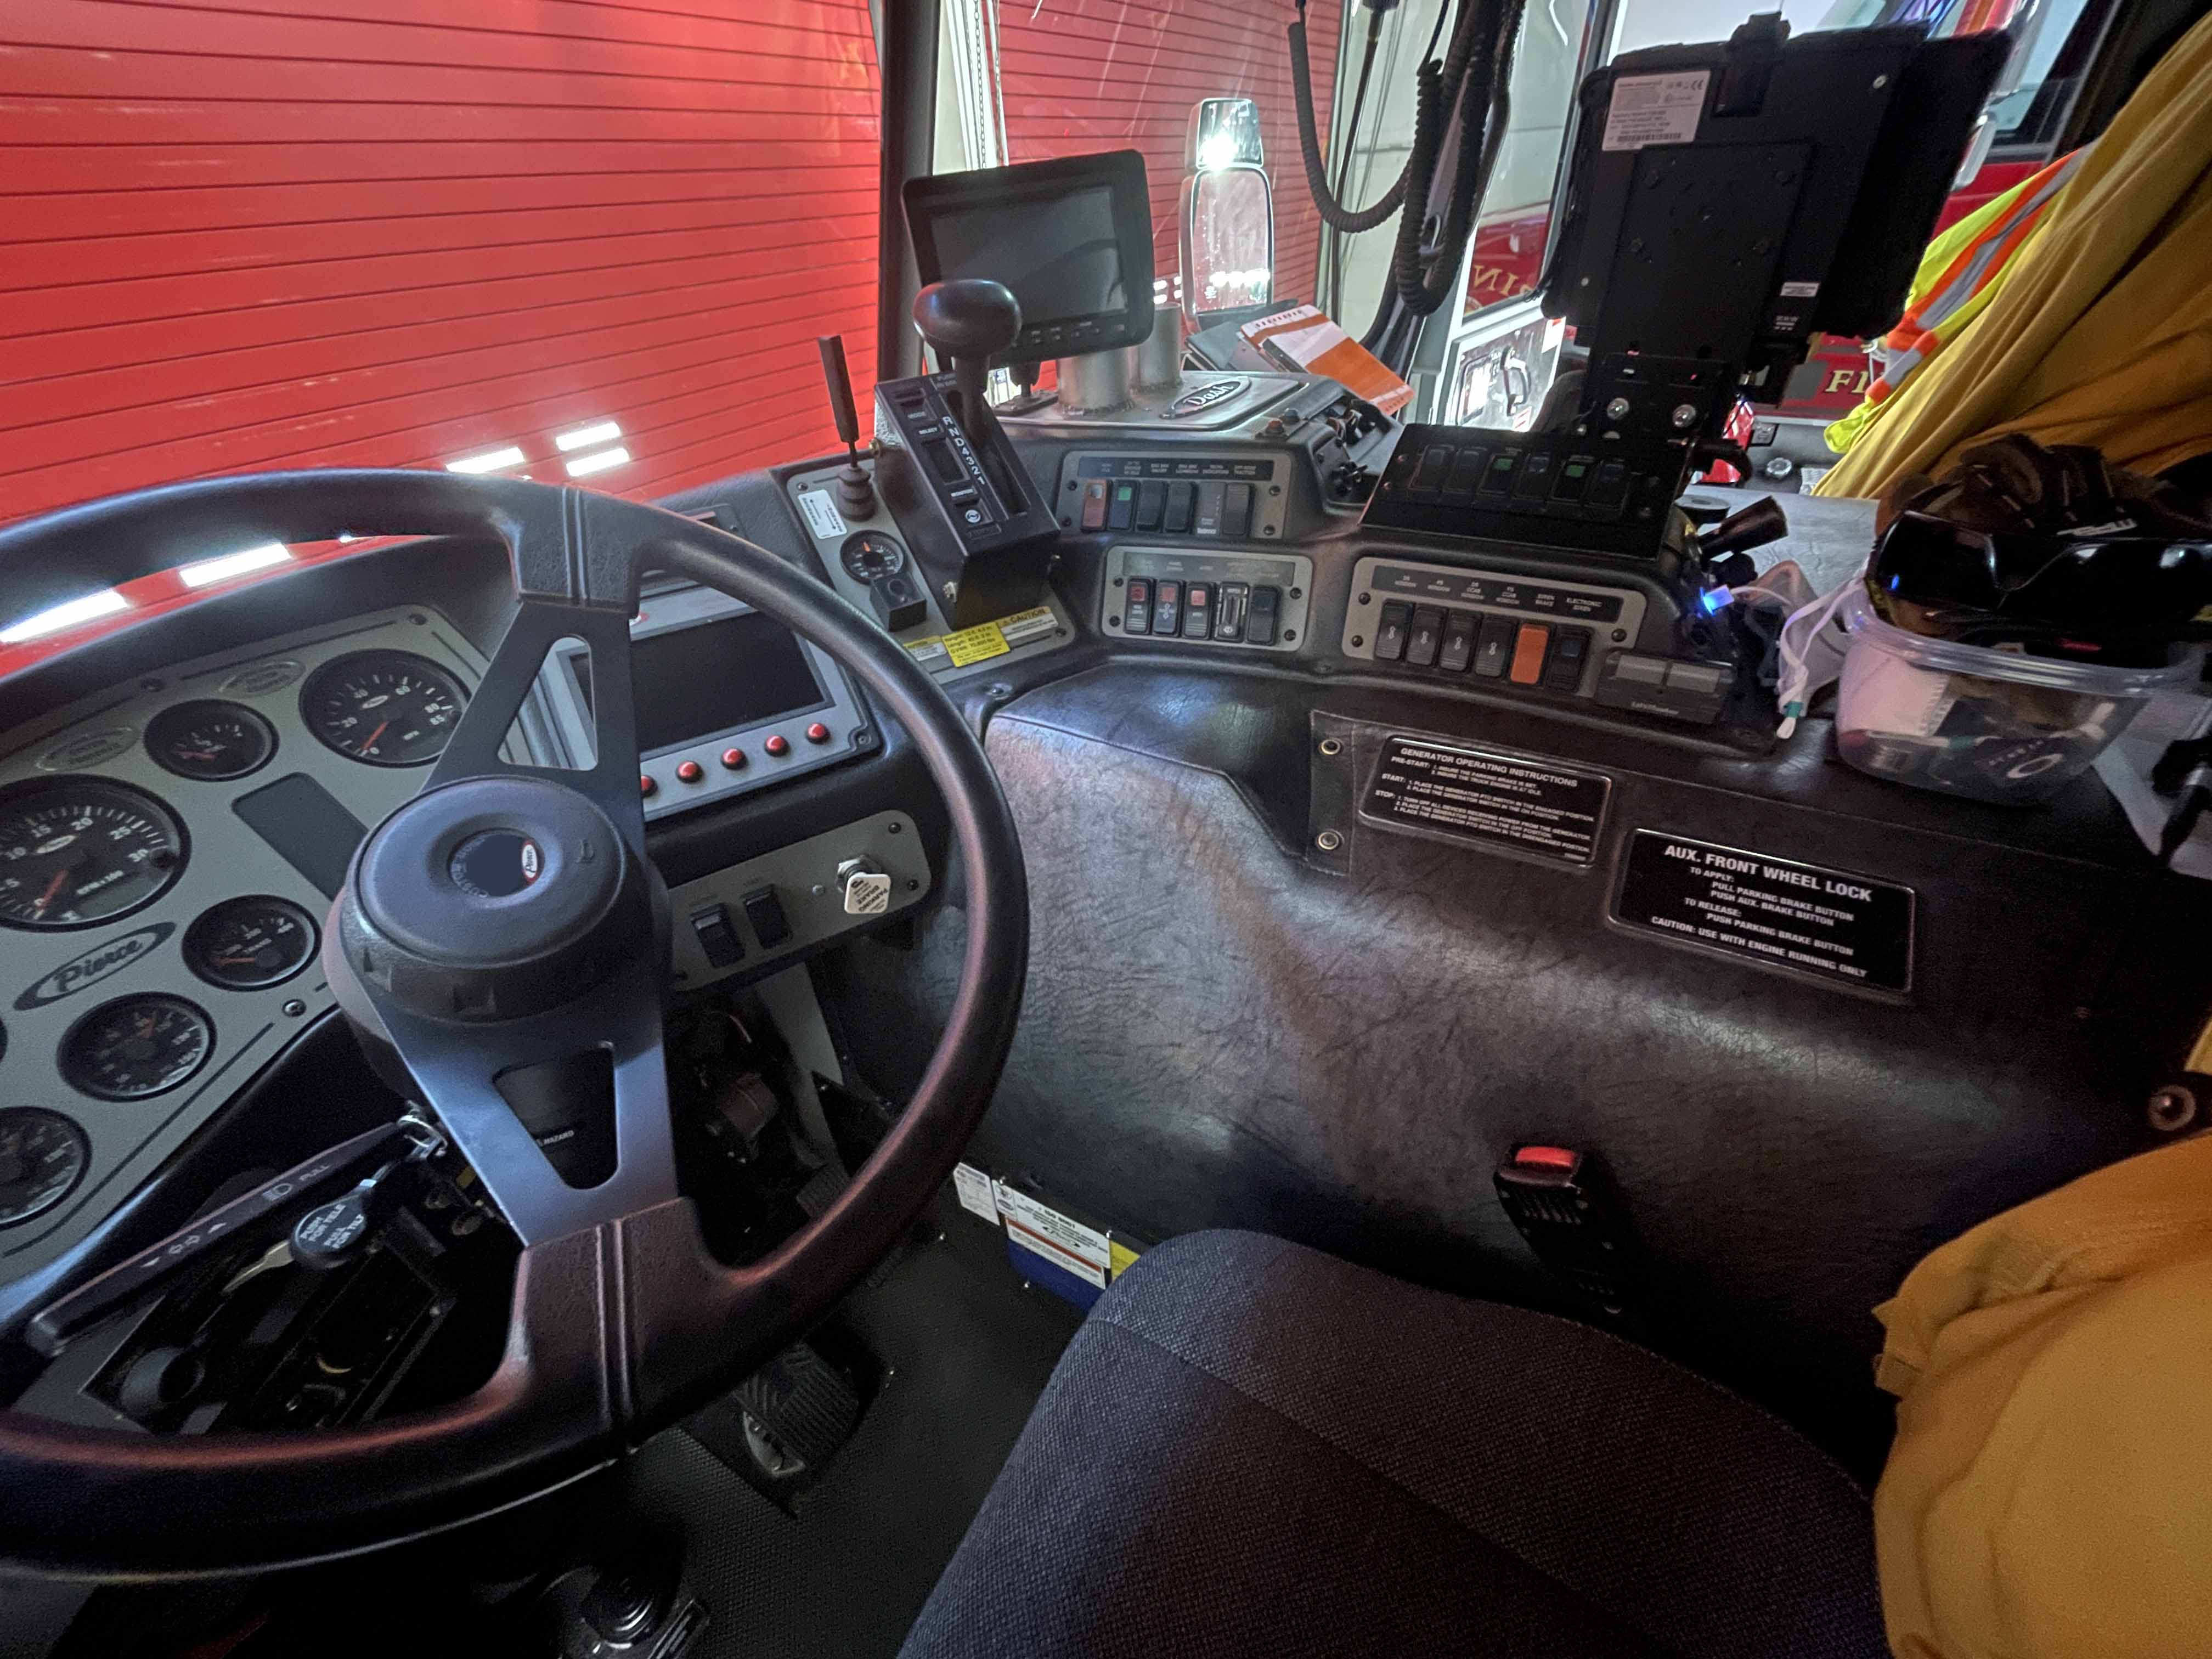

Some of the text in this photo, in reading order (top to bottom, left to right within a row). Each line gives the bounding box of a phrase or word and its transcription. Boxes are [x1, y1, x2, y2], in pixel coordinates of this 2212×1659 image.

[1183, 386, 1234, 405] Dash
[942, 416, 953, 425] R
[948, 427, 960, 437] N
[955, 438, 964, 447] D
[962, 448, 969, 456] 4
[966, 456, 974, 465] 3
[971, 466, 980, 475] 2
[1010, 608, 1046, 624] CAUTION
[354, 689, 368, 698] 40
[396, 686, 410, 695] 60
[425, 703, 439, 713] 80
[342, 717, 357, 727] 20
[430, 715, 445, 725] 85
[1391, 756, 1430, 768] PRE-START:
[1401, 748, 1578, 787] GENERATOR OPERATING INSTRUCTIONS
[1382, 773, 1406, 782] START:
[1375, 789, 1396, 799] STOP:
[1413, 786, 1431, 794] PLACE
[1400, 807, 1418, 815] PLACE
[1402, 802, 1420, 810] PLACE
[31, 825, 52, 837] 15
[71, 817, 93, 830] 20
[110, 826, 131, 839] 25
[5, 847, 26, 860] 10
[128, 849, 149, 862] 30
[1664, 845, 1872, 902] AUX. FRONT WHEEL LOCK
[1690, 866, 1734, 882] TO APPLY:
[5, 878, 20, 888] 5
[856, 885, 879, 904] BRAKE
[858, 888, 888, 912] PARKING
[1712, 881, 1854, 922] PULL PARKING BRAKE BUTTON
[1684, 898, 1742, 917] TO RELEASE:
[1711, 890, 1835, 927] PUSH AUX. BRAKE BUTTON
[1706, 912, 1854, 956] PUSH PARKING BRAKE BUTTON
[1651, 916, 1868, 977] CAUTION: USE WITH ENGINE RUNNING ONLY
[52, 940, 143, 992] Pierce
[544, 1130, 574, 1145] HAZARD
[300, 1216, 324, 1239] PUSH
[308, 1204, 346, 1242] FOR TELE
[324, 1227, 346, 1246] PULL
[332, 1214, 364, 1249] FOR TILT
